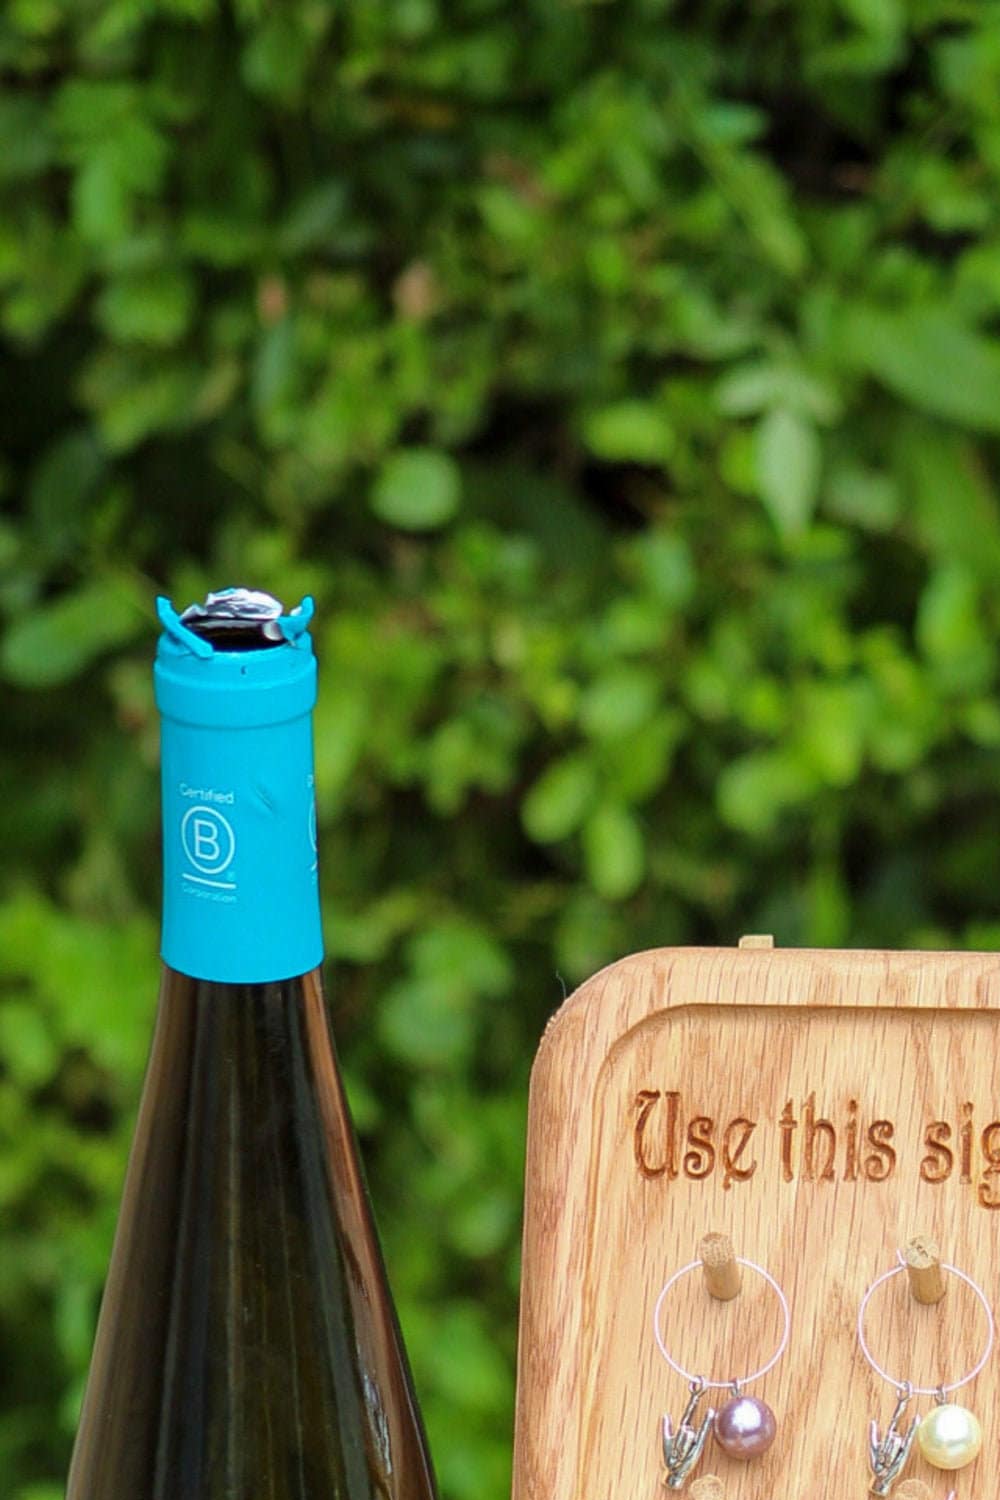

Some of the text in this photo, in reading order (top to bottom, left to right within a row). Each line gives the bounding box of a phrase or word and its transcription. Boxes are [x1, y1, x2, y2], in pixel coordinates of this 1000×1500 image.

[180, 783, 234, 804] Certified
[194, 819, 220, 860] B
[634, 1089, 758, 1191] Use
[778, 1090, 897, 1183] this
